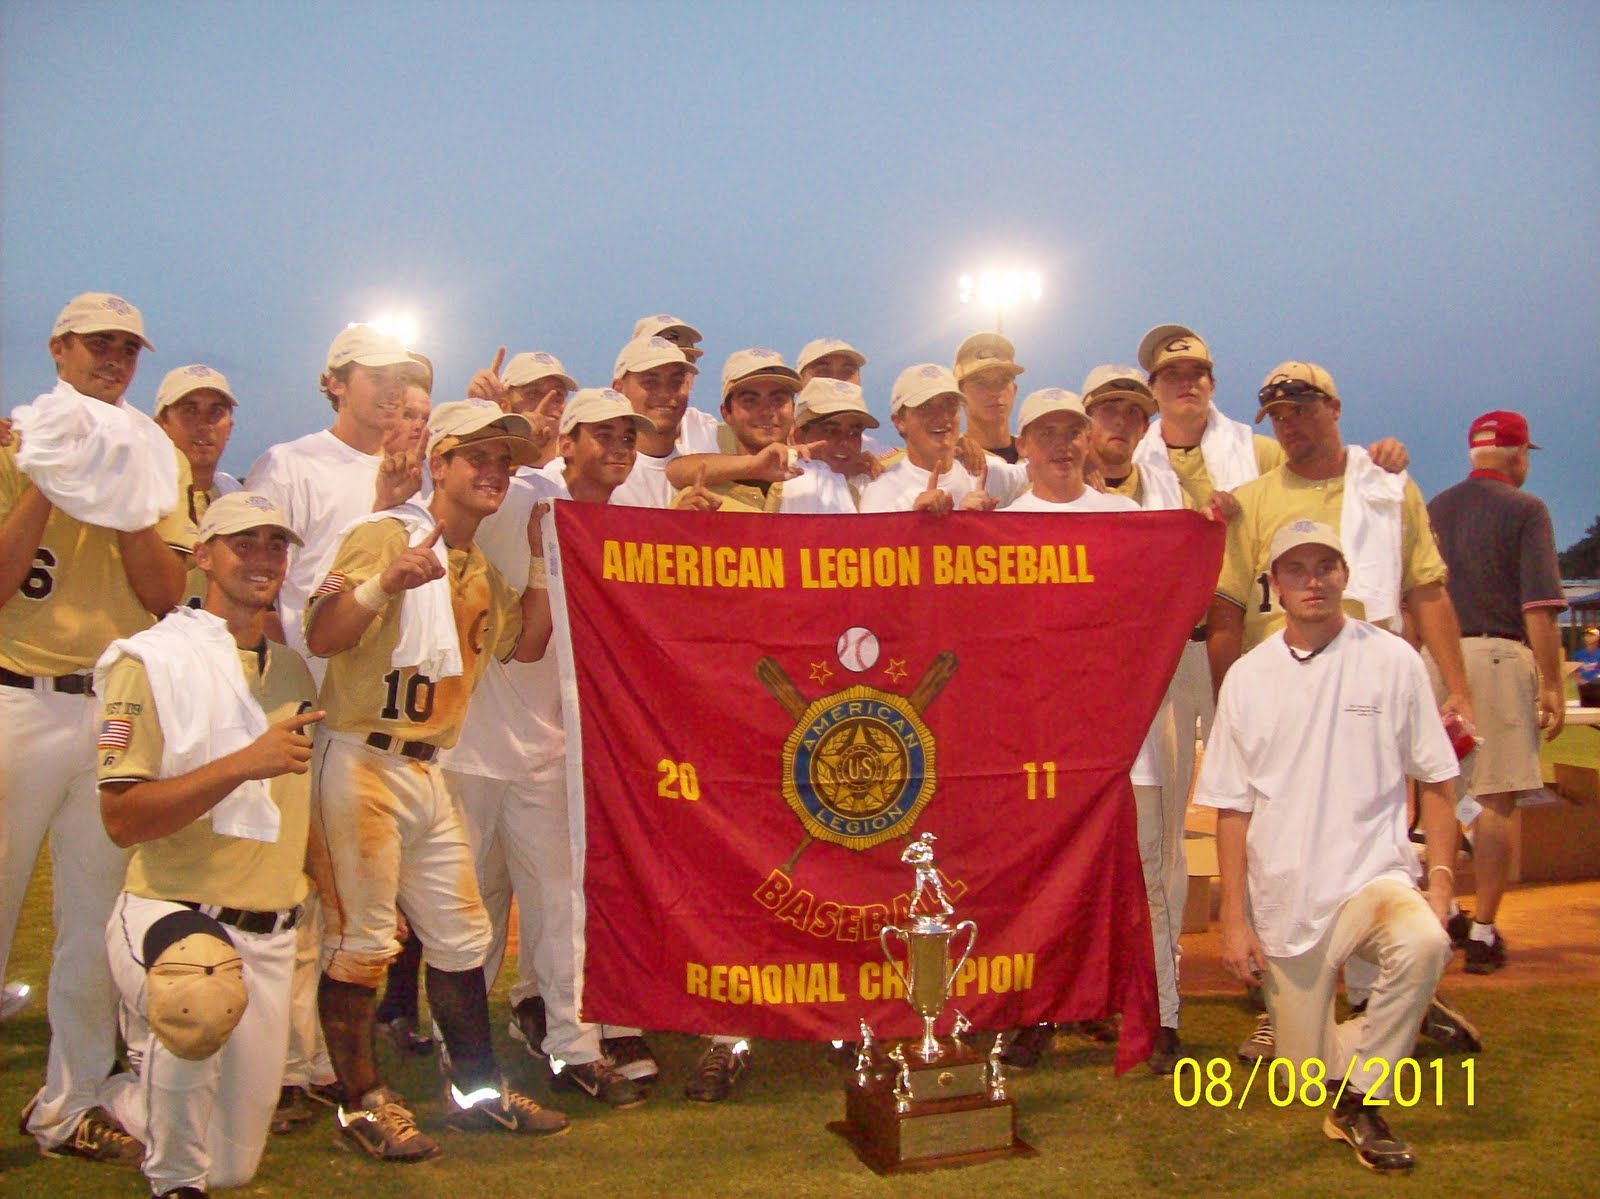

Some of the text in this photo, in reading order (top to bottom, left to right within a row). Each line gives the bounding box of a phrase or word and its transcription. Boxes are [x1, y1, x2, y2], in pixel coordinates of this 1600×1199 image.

[602, 539, 785, 589] AMERICAN
[800, 545, 921, 589] LEGION
[932, 544, 1096, 585] BASEBALL
[380, 668, 436, 723] 10
[802, 702, 919, 752] AMERICAN
[657, 758, 701, 801] 20
[1022, 761, 1056, 800] 11
[815, 806, 904, 834] LEGION
[752, 868, 968, 942] BASEBL
[686, 952, 1035, 1005] REGIONAL CHPION
